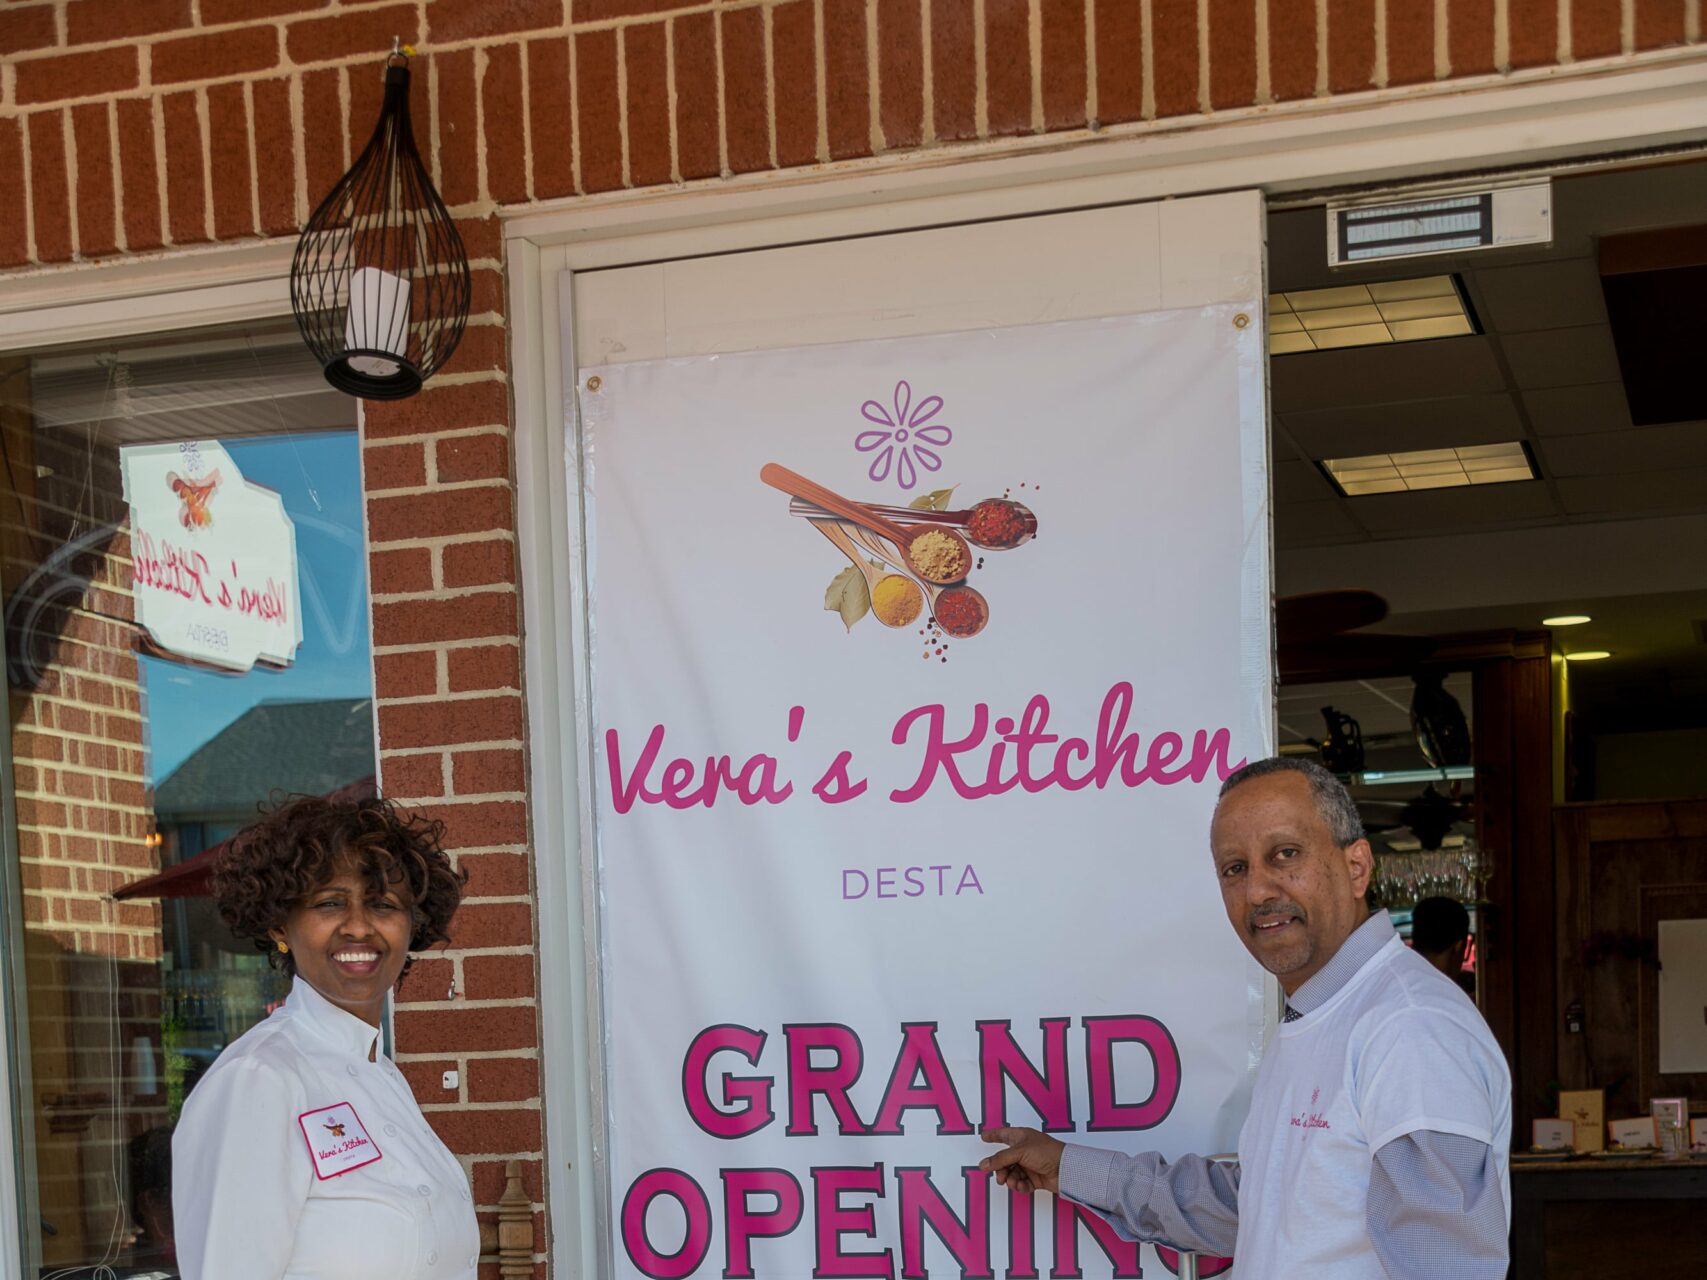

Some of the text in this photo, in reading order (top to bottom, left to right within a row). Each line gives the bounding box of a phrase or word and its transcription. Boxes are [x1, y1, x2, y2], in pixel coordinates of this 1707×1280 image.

[606, 681, 1247, 814] Vera's Kitchen
[842, 864, 984, 900] DESTA
[681, 1014, 1182, 1140] GRAND
[319, 1144, 342, 1160] Vera's
